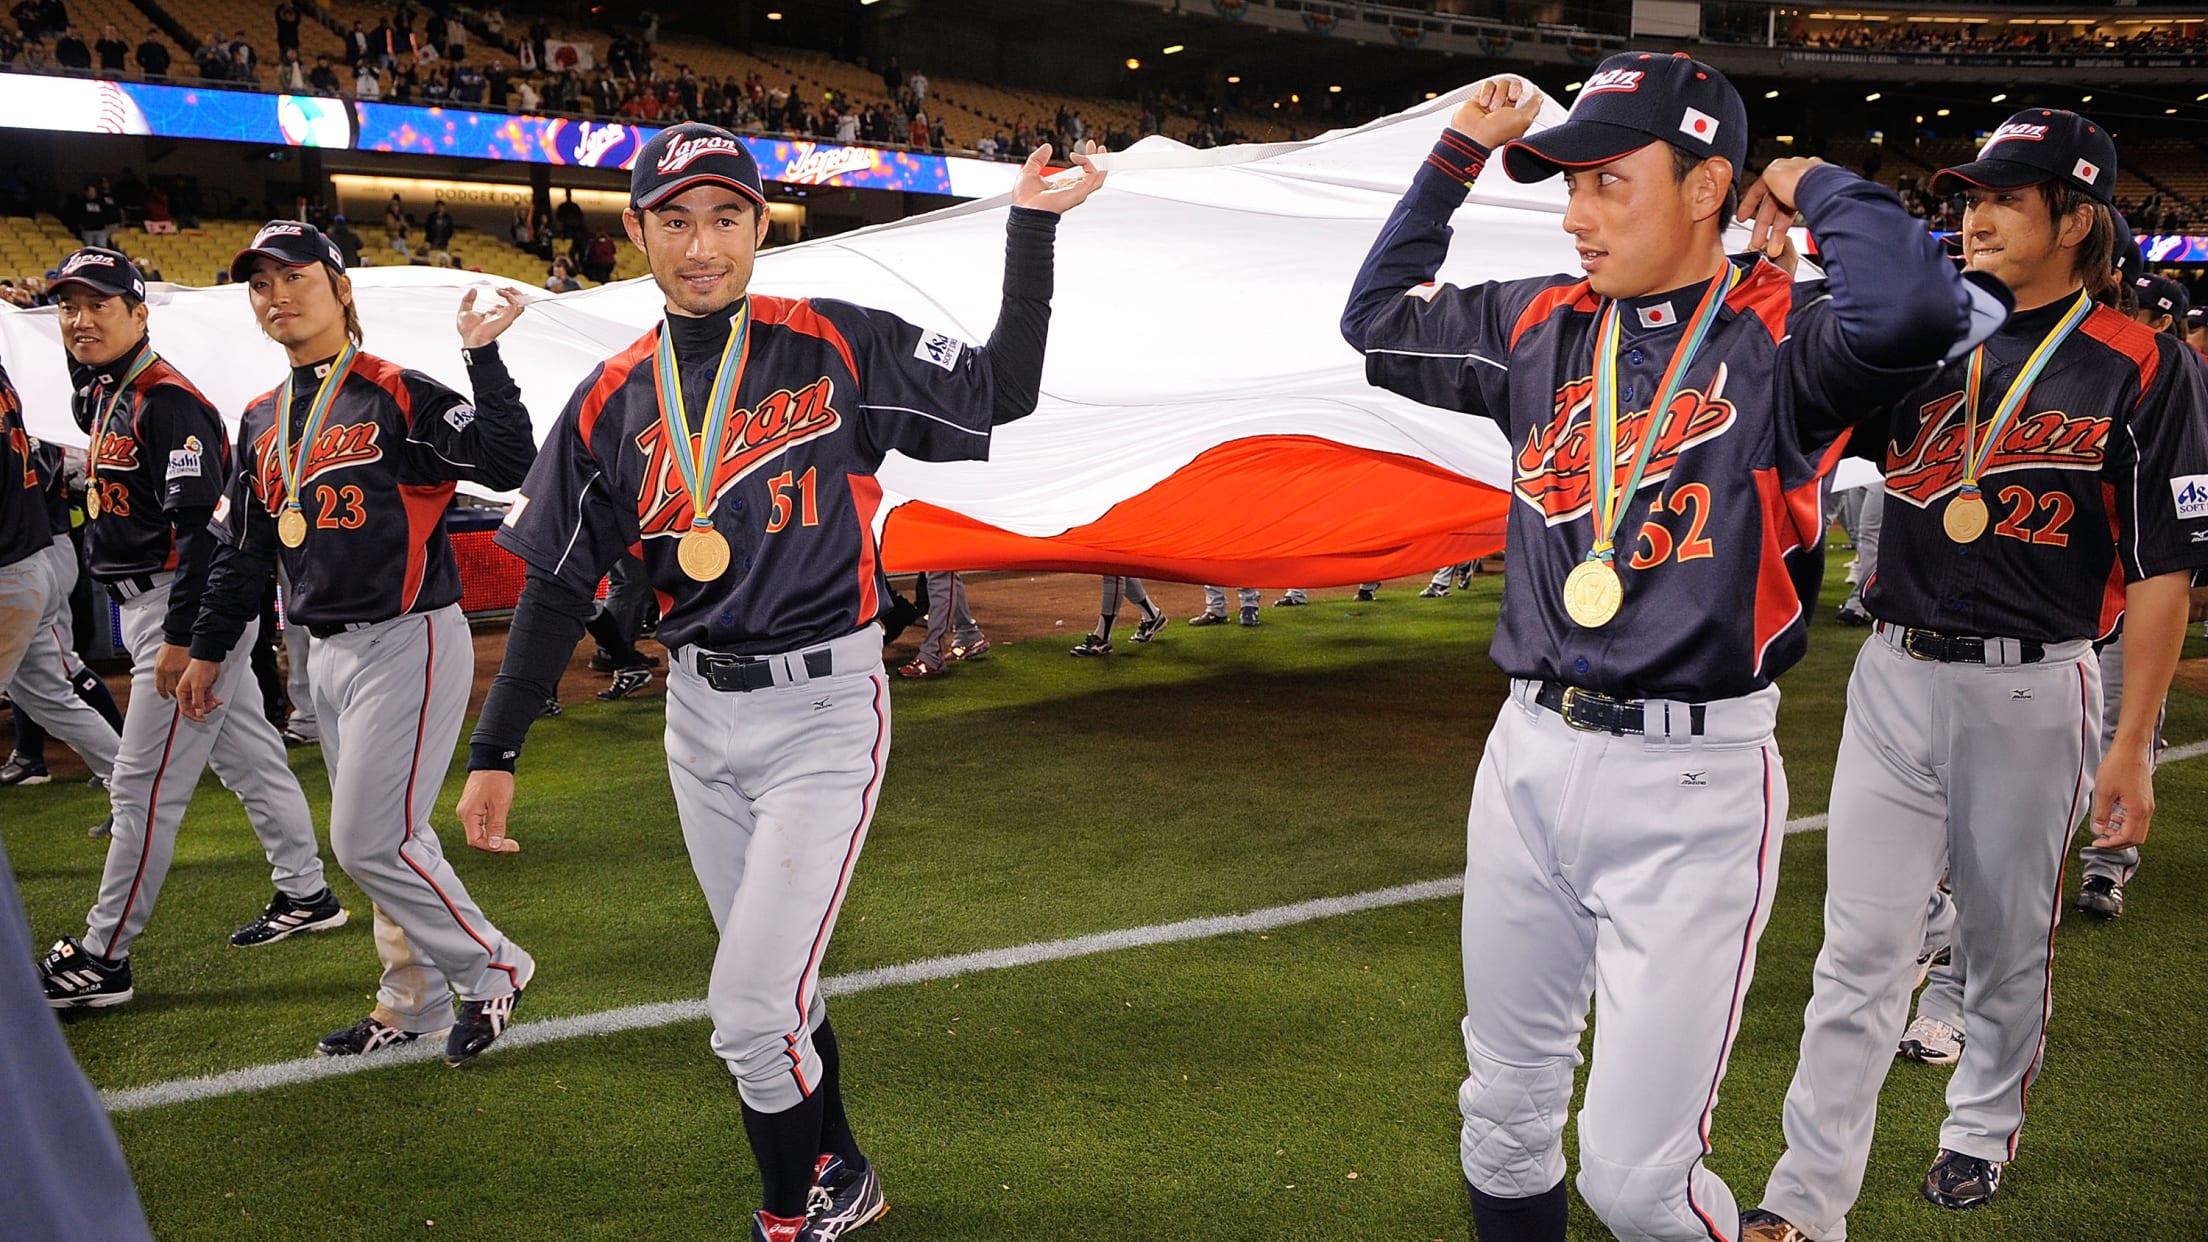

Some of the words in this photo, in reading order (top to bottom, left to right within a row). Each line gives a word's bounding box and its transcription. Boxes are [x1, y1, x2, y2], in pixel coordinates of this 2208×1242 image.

[657, 133, 740, 176] Japan
[434, 188, 496, 201] DODGER
[168, 454, 198, 469] sahi
[315, 484, 367, 529] 23
[766, 466, 819, 533] 51
[1993, 484, 2075, 547] 22
[2180, 503, 2205, 513] SOFT
[1629, 482, 1713, 570] 52
